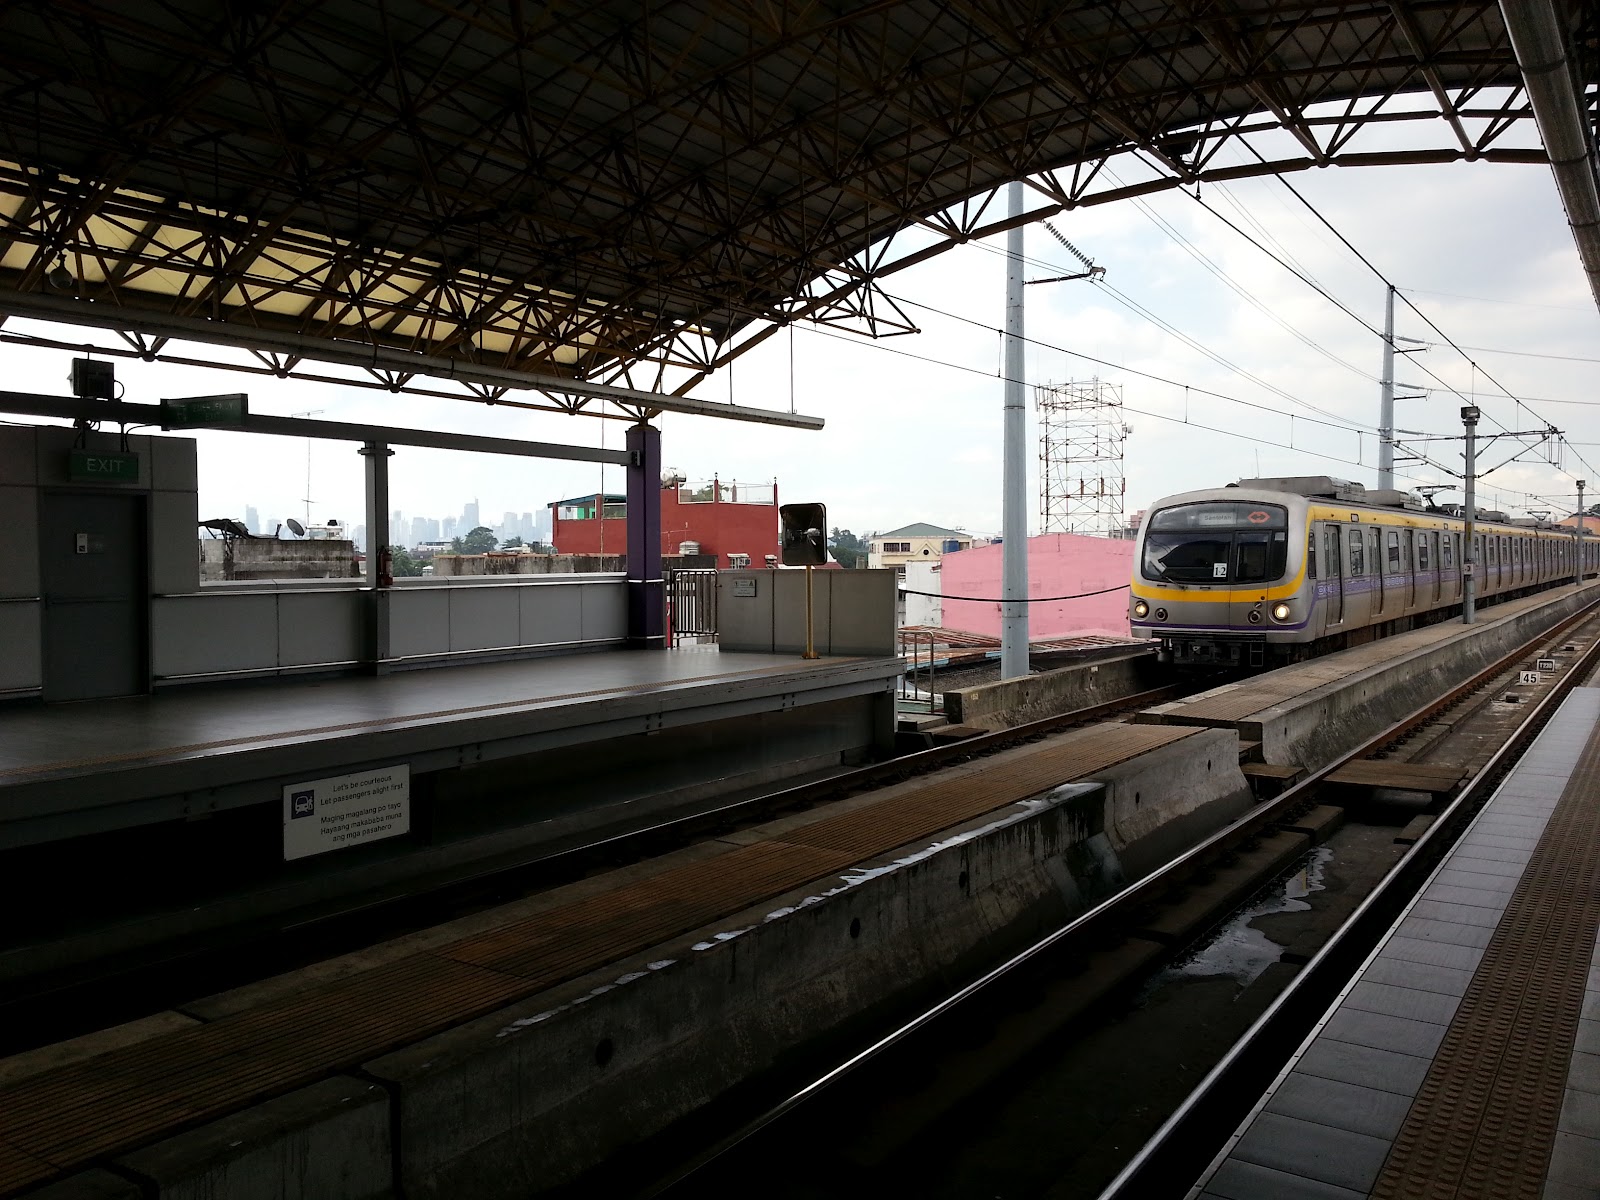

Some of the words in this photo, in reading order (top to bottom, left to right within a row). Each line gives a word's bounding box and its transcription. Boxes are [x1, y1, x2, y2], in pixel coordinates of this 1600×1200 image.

[87, 458, 124, 472] EXIT
[1215, 566, 1226, 576] 12
[1524, 674, 1536, 683] 45
[333, 783, 348, 792] Let's
[360, 776, 392, 787] courteous
[320, 798, 331, 806] Let
[333, 790, 371, 804] passengers
[372, 786, 389, 795] alight
[390, 782, 403, 790] first
[320, 812, 344, 824] Maging
[346, 806, 376, 818] magalang
[378, 805, 386, 814] po
[388, 802, 402, 810] tayo
[320, 823, 350, 835] Hayaang
[350, 816, 384, 828] makababa
[385, 812, 402, 821] muna
[332, 834, 345, 842] ang
[346, 831, 360, 840] mga
[362, 824, 392, 837] pasahero
